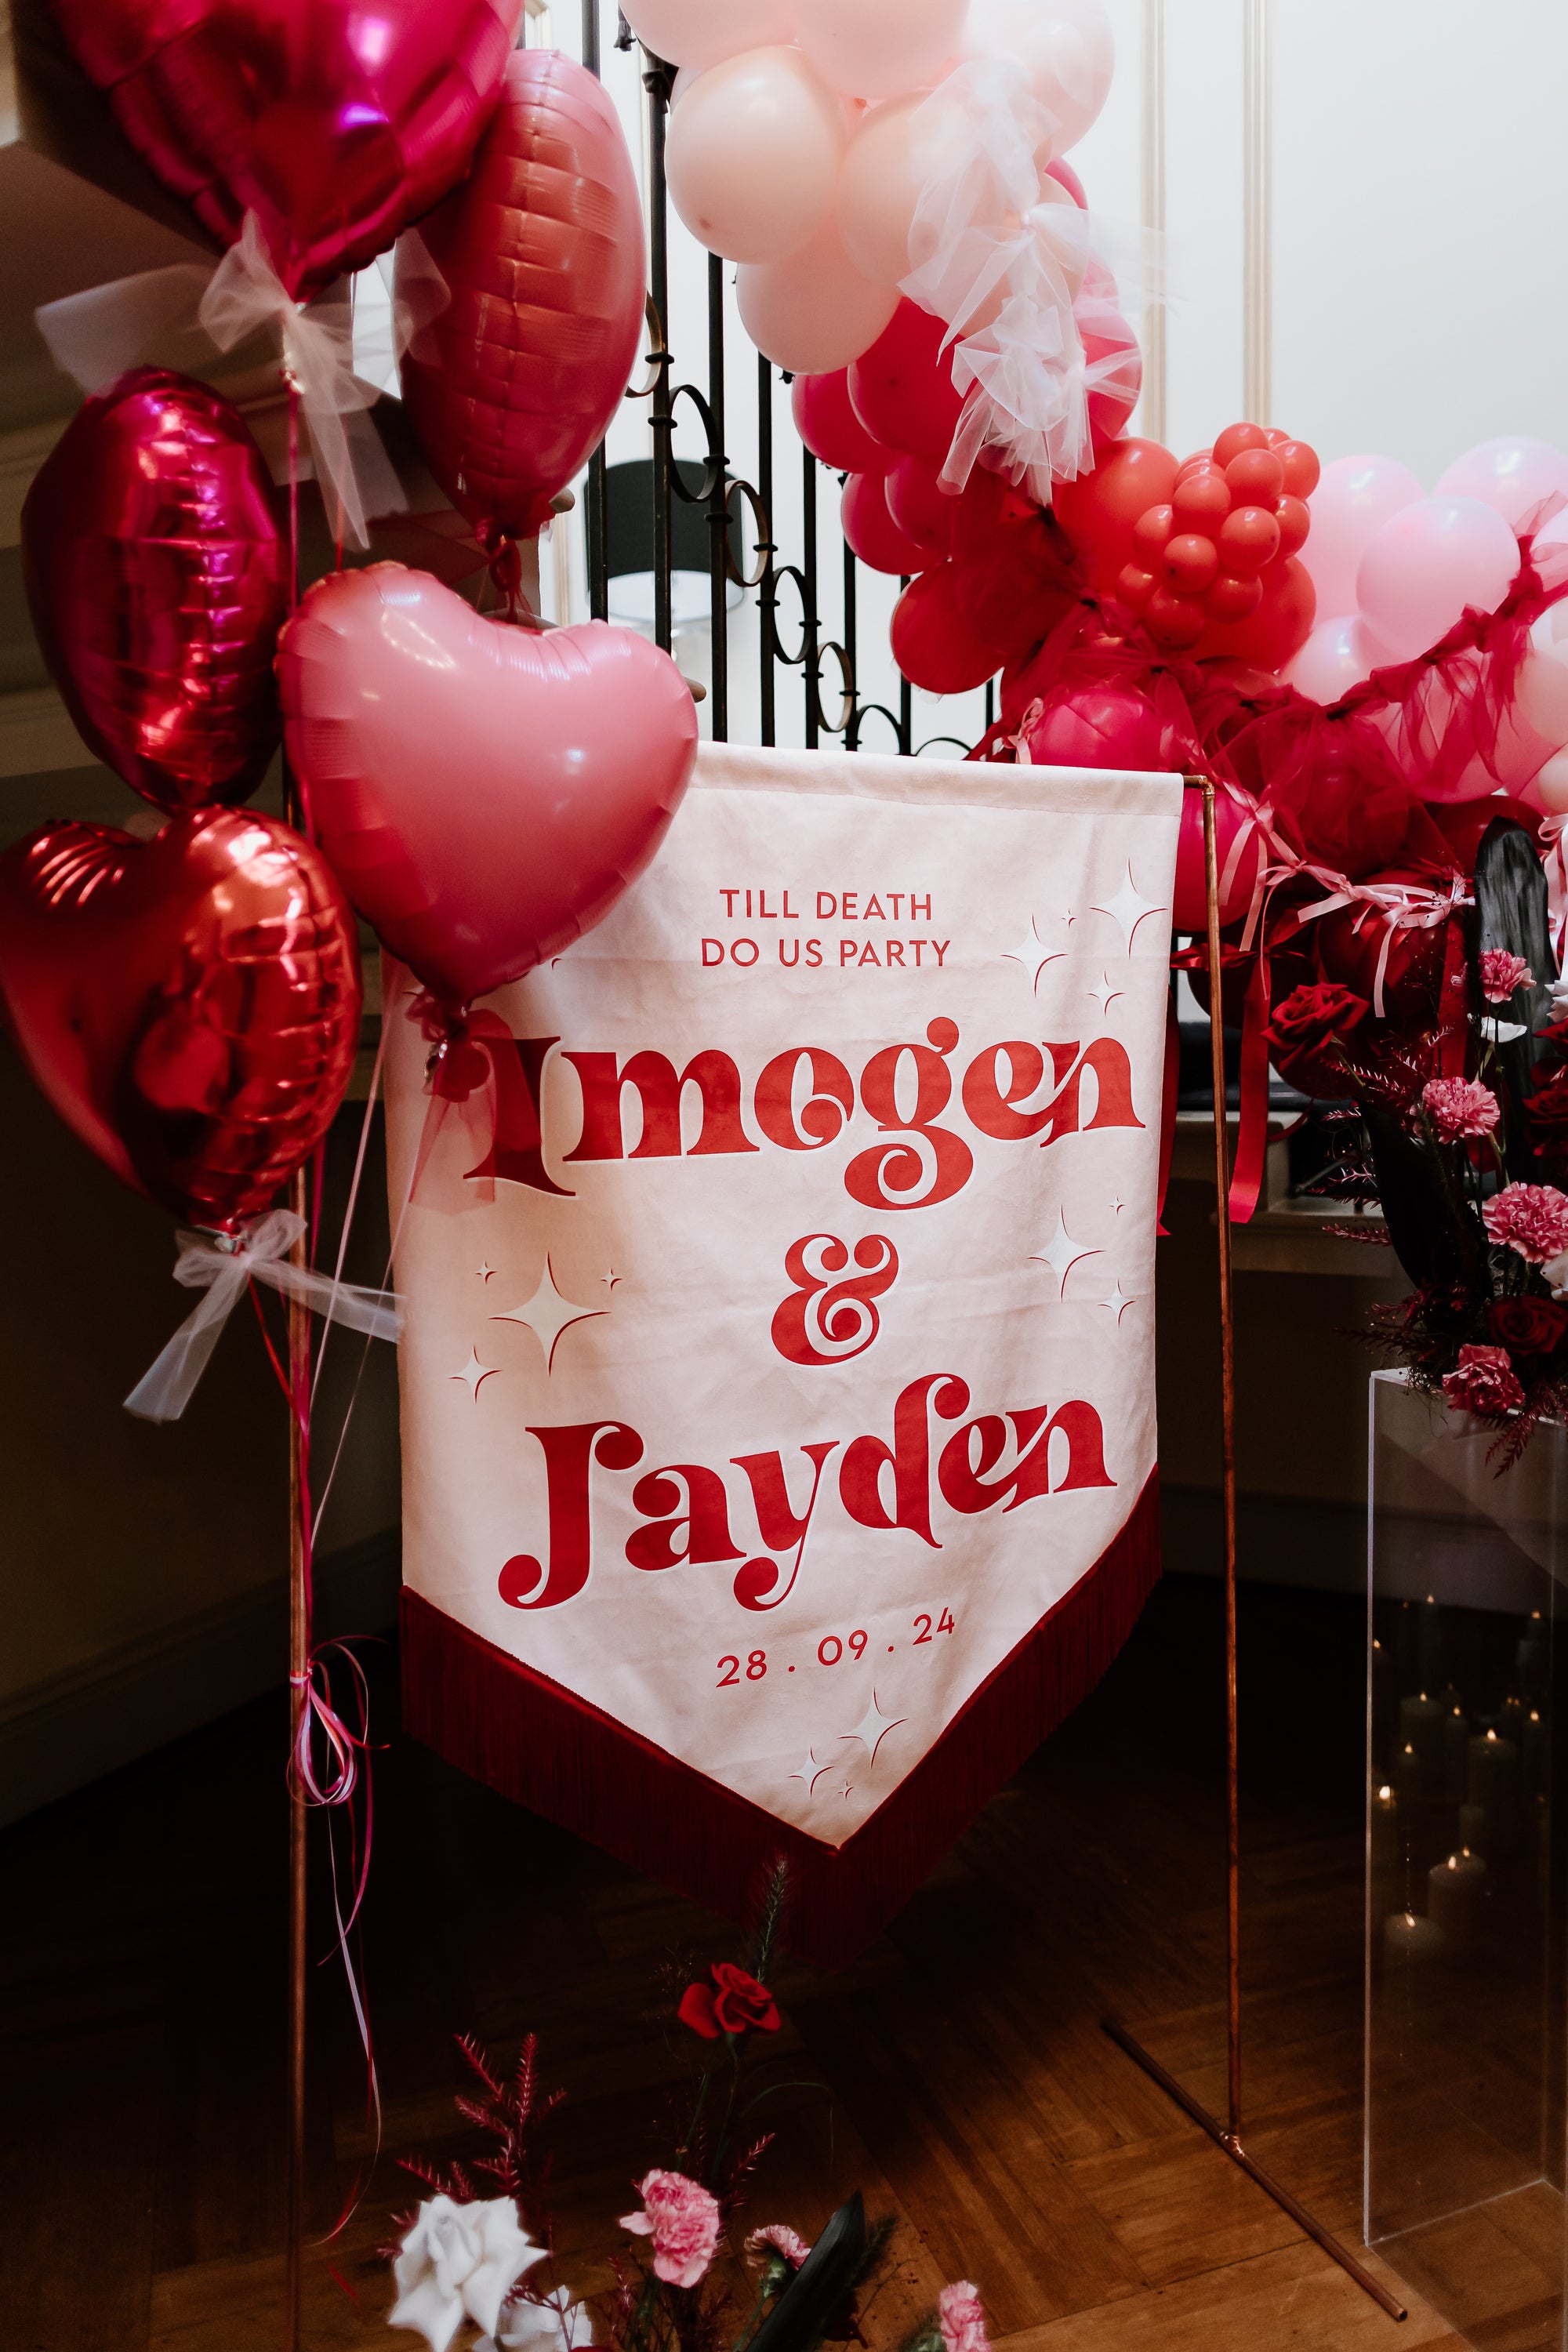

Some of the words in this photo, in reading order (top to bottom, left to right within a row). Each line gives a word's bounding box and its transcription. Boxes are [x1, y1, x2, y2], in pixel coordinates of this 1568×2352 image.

[701, 938, 760, 967] DO
[779, 938, 823, 968] US
[840, 939, 951, 967] PARTY
[719, 888, 800, 919] TILL
[816, 891, 932, 920] DEATH
[451, 1016, 1146, 1211] Imogen
[770, 1233, 899, 1367] &
[497, 1373, 1118, 1612] Jayden
